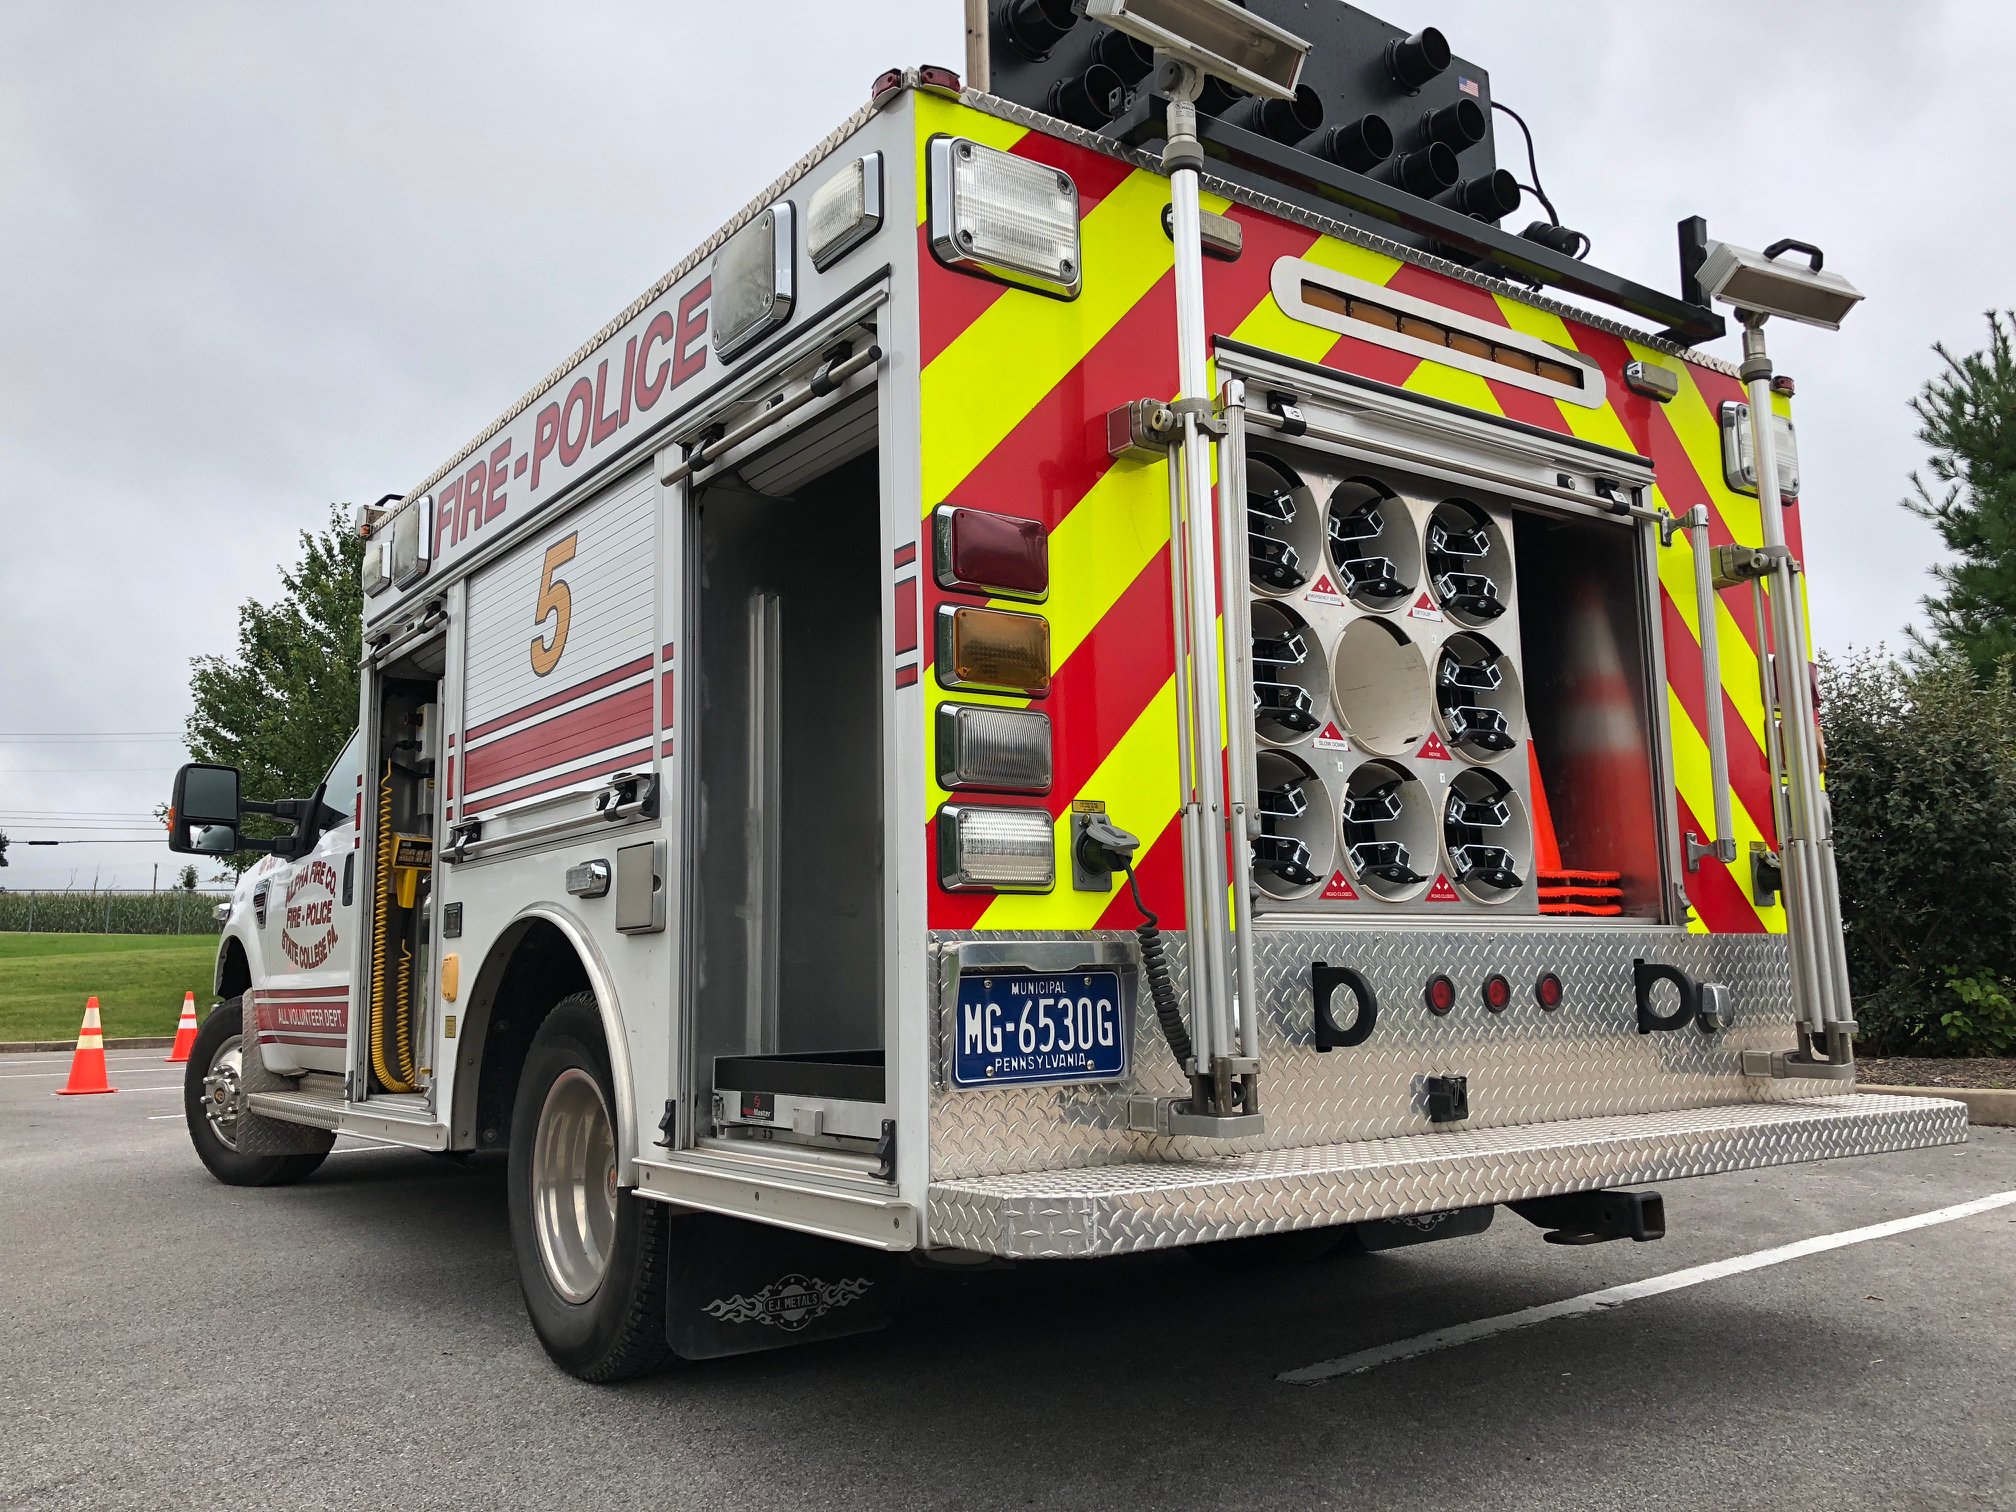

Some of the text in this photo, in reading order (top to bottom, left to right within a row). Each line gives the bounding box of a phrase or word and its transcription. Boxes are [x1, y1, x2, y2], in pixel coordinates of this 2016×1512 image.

[433, 275, 712, 560] FIRE-POLICE
[530, 529, 578, 677] 5
[285, 864, 309, 908] ALPHA
[309, 860, 327, 886] FIRE
[281, 927, 299, 966] STATE
[299, 935, 328, 970] COLLEGE
[1011, 981, 1067, 996] MUNICIPAL
[278, 1008, 345, 1028] ALL VOLUNTEER DEPT.
[964, 997, 1114, 1055] MG-6530G
[995, 1052, 1087, 1073] PENNSYLVANIA
[784, 1293, 818, 1309] METALS
